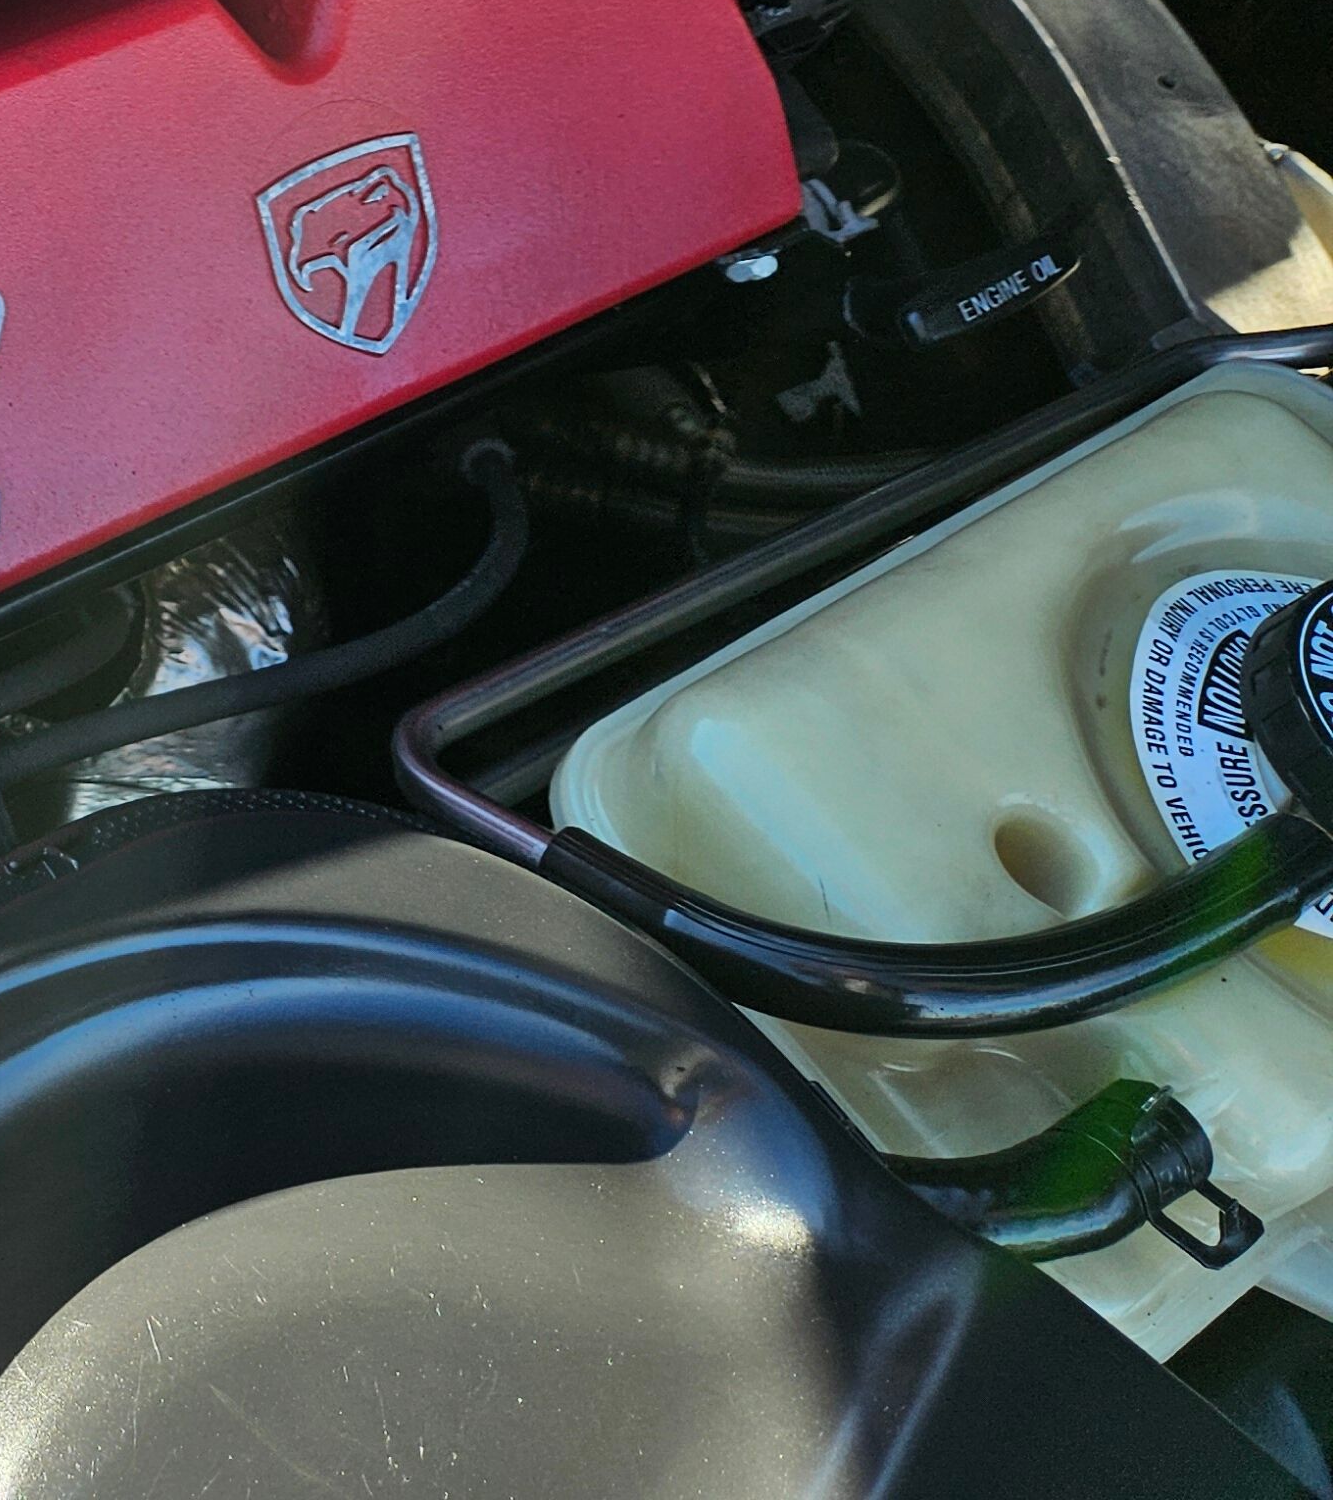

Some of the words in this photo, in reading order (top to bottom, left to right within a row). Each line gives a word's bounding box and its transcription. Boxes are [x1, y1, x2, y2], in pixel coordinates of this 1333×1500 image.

[957, 270, 1031, 322] ENGINE
[1030, 255, 1062, 283] OIL
[1186, 578, 1277, 606] PERSONAL
[1158, 597, 1199, 643] INJURY
[1199, 627, 1217, 644] IS
[1209, 605, 1262, 633] GLYCOL
[1148, 638, 1174, 668] OR
[1142, 668, 1169, 756] DAMAGE
[1174, 639, 1209, 758] RECOMMENDED
[1151, 762, 1178, 789] TO
[1216, 741, 1268, 828] SSURE
[1165, 797, 1211, 861] VEHIC
